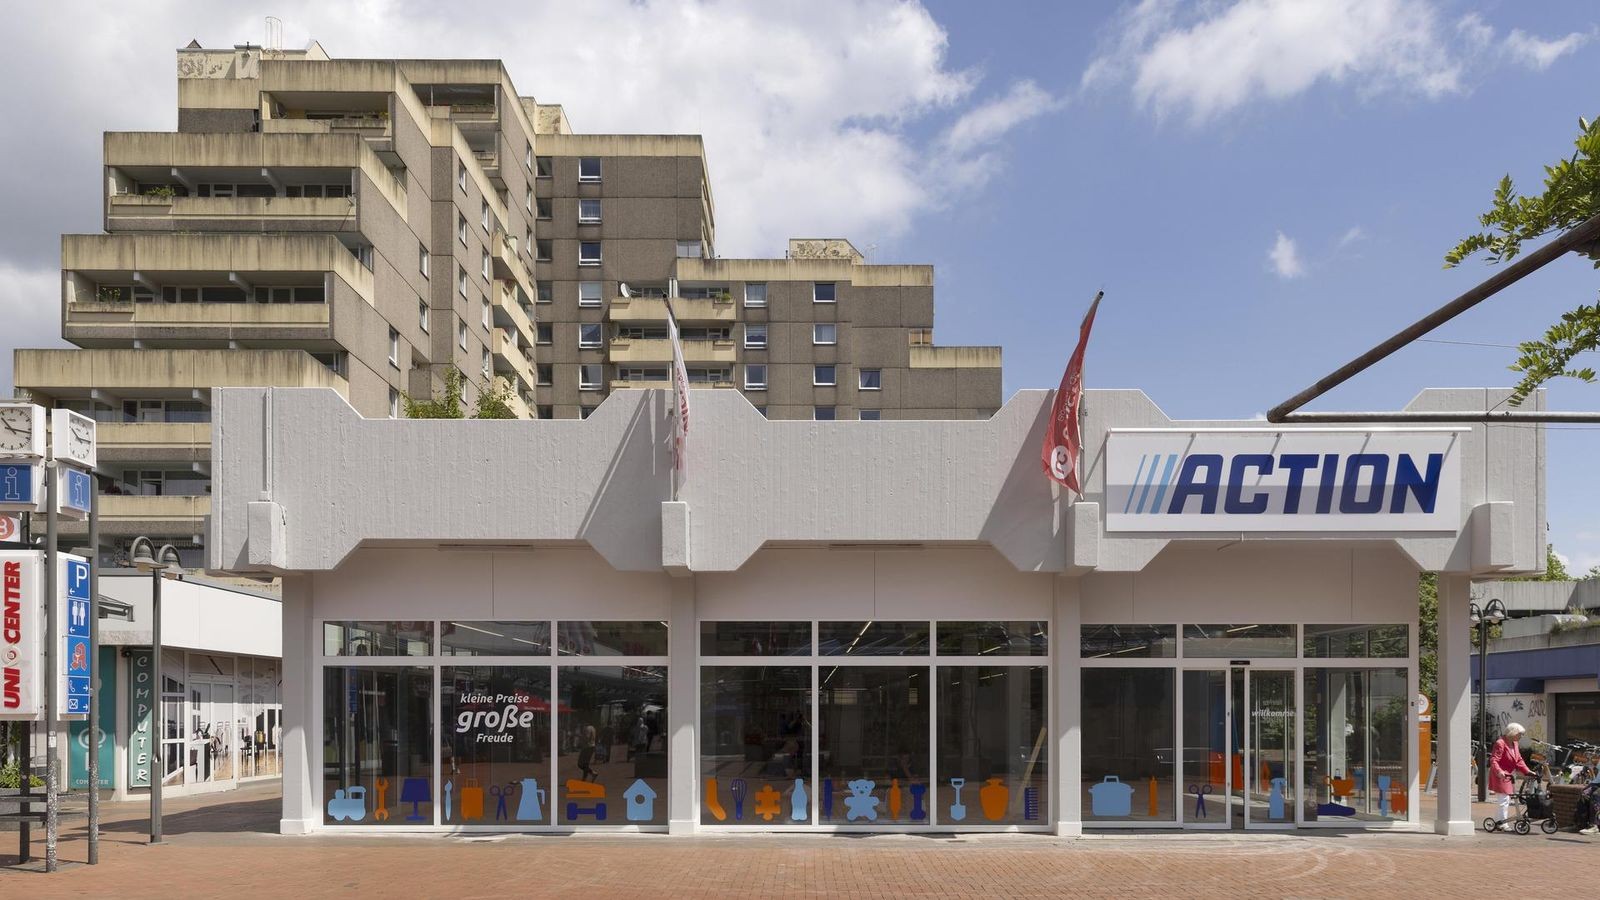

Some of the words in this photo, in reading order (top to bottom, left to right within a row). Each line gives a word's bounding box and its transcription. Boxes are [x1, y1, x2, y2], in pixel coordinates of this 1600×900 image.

[1167, 453, 1443, 515] ACTION
[76, 564, 88, 588] P
[3, 561, 21, 645] CENTER
[460, 693, 493, 703] kleine
[496, 693, 529, 703] Preise
[136, 656, 149, 782] COMPUTER
[456, 704, 534, 733] große
[476, 733, 513, 743] Freude
